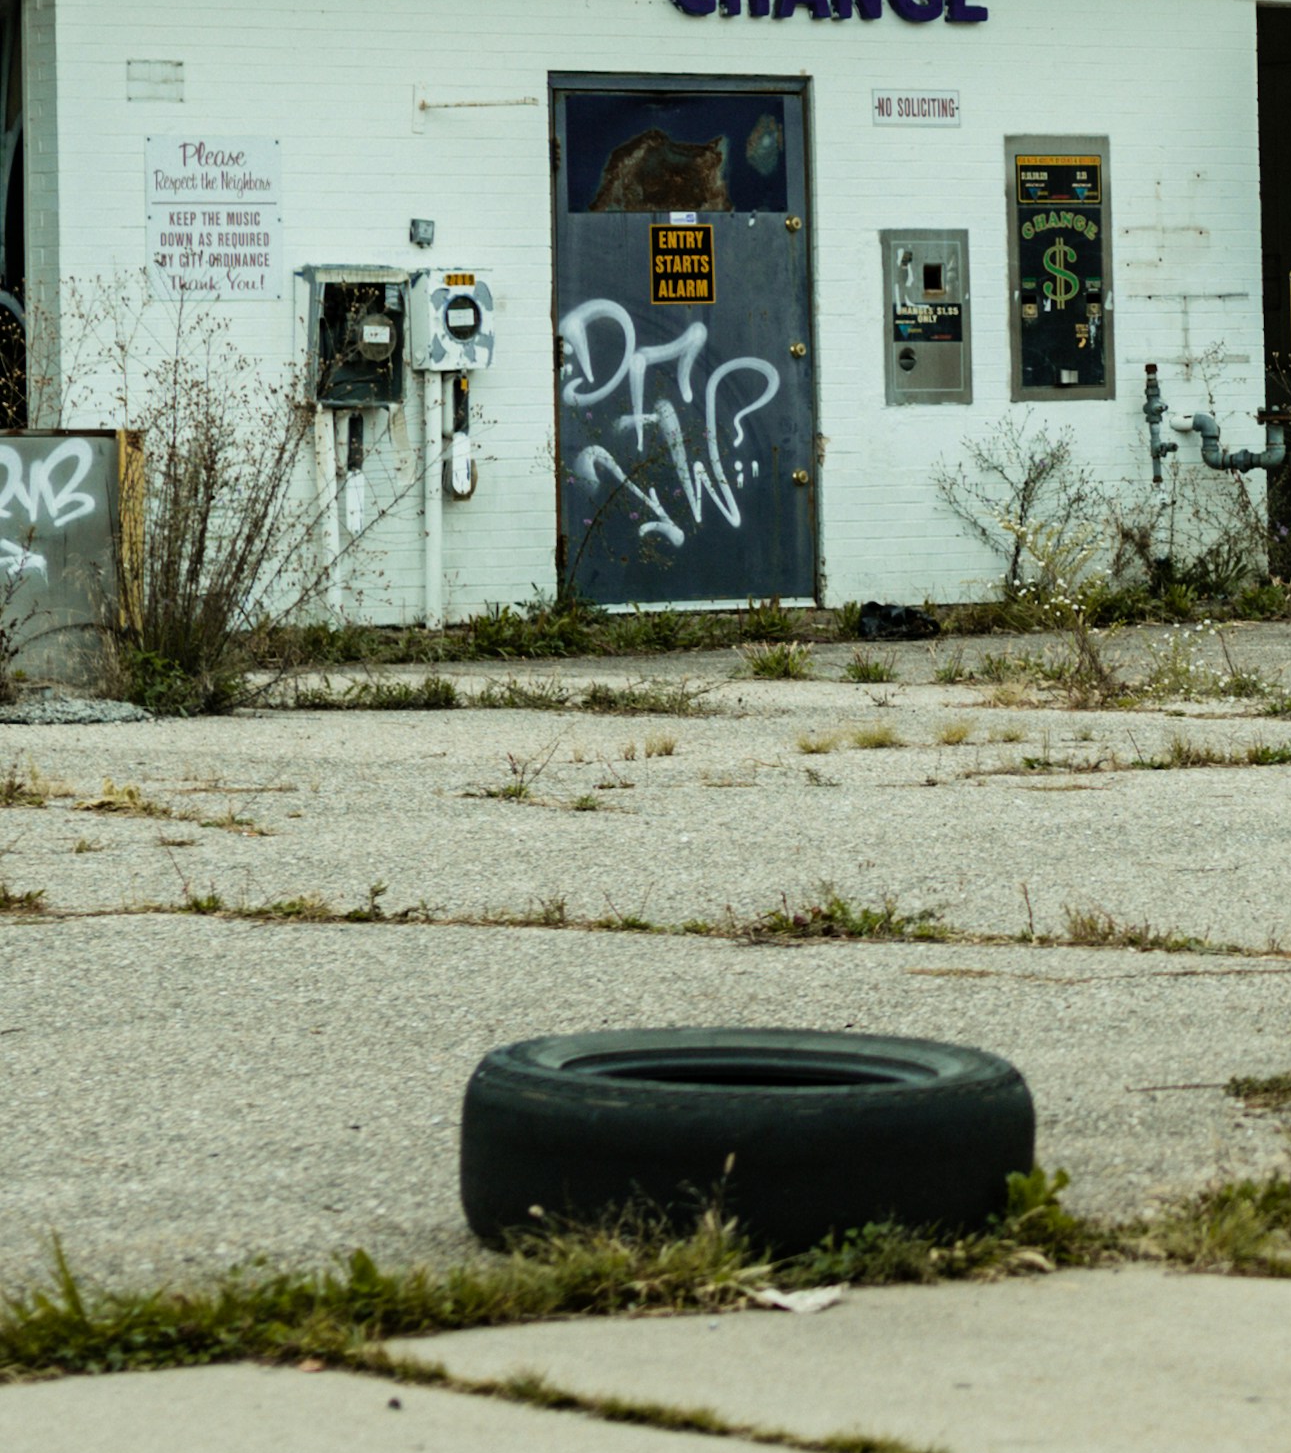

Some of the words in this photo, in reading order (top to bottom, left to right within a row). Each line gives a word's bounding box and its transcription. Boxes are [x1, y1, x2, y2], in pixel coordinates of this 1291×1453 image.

[878, 97, 892, 117] NO
[897, 97, 955, 118] SOLICITING
[179, 141, 246, 167] Please
[154, 169, 197, 195] Respect
[201, 171, 218, 191] the
[221, 170, 271, 199] Neighbors
[169, 211, 197, 226] KEEP
[202, 211, 221, 226] THE
[226, 211, 261, 226] MUSIC
[1021, 210, 1099, 241] CHANGE
[160, 232, 193, 247] DOWN
[198, 232, 212, 247] AS
[218, 232, 270, 250] REQUIRED
[658, 230, 704, 249] ENTRY
[161, 253, 173, 267] BY
[179, 253, 202, 267] CITY
[208, 253, 270, 268] ORDINANCE
[655, 255, 709, 273] STARTS
[169, 274, 221, 291] Thank
[227, 272, 265, 291] You!
[658, 279, 709, 298] ALARM
